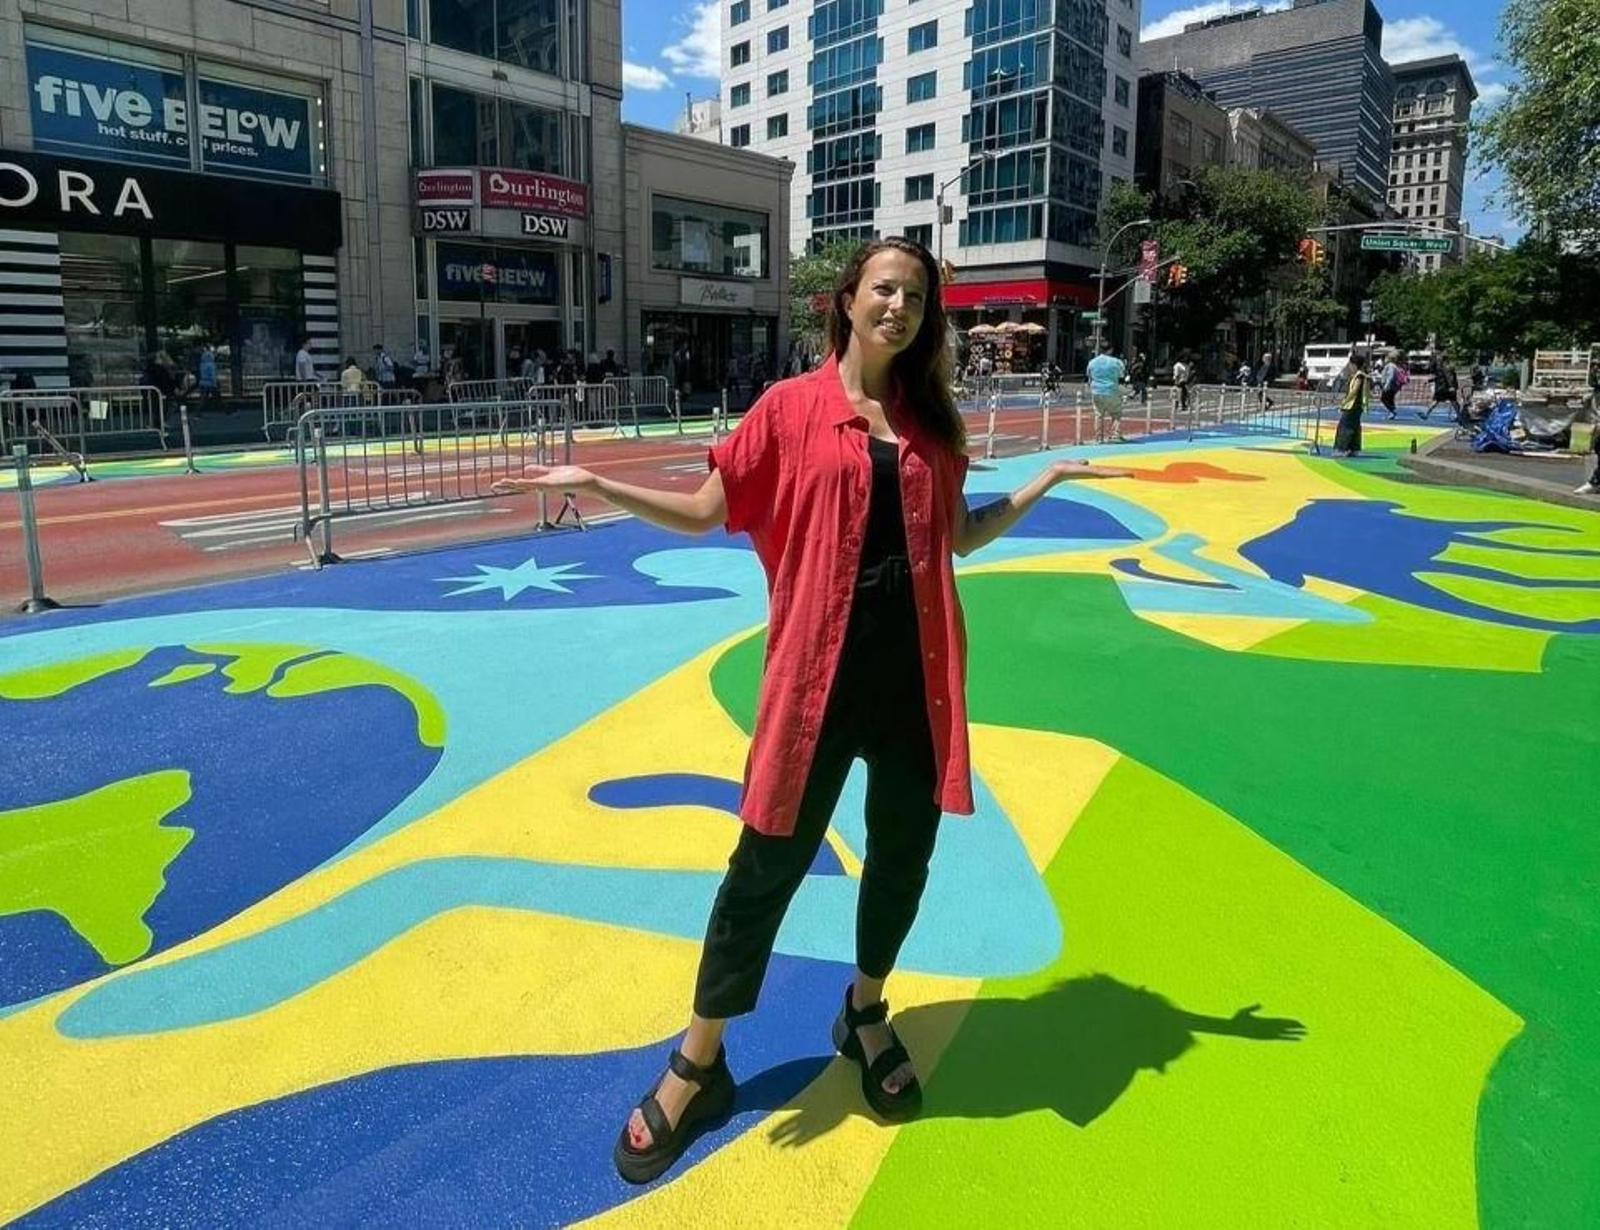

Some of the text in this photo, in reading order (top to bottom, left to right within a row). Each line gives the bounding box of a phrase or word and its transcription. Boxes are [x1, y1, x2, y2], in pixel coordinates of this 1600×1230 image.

[34, 76, 151, 126] five
[98, 122, 258, 157] hot stuff. cl prices.
[489, 173, 584, 207] Burlington
[424, 211, 468, 230] DSW
[524, 213, 567, 237] DSW
[1365, 238, 1448, 249] Union Squar West
